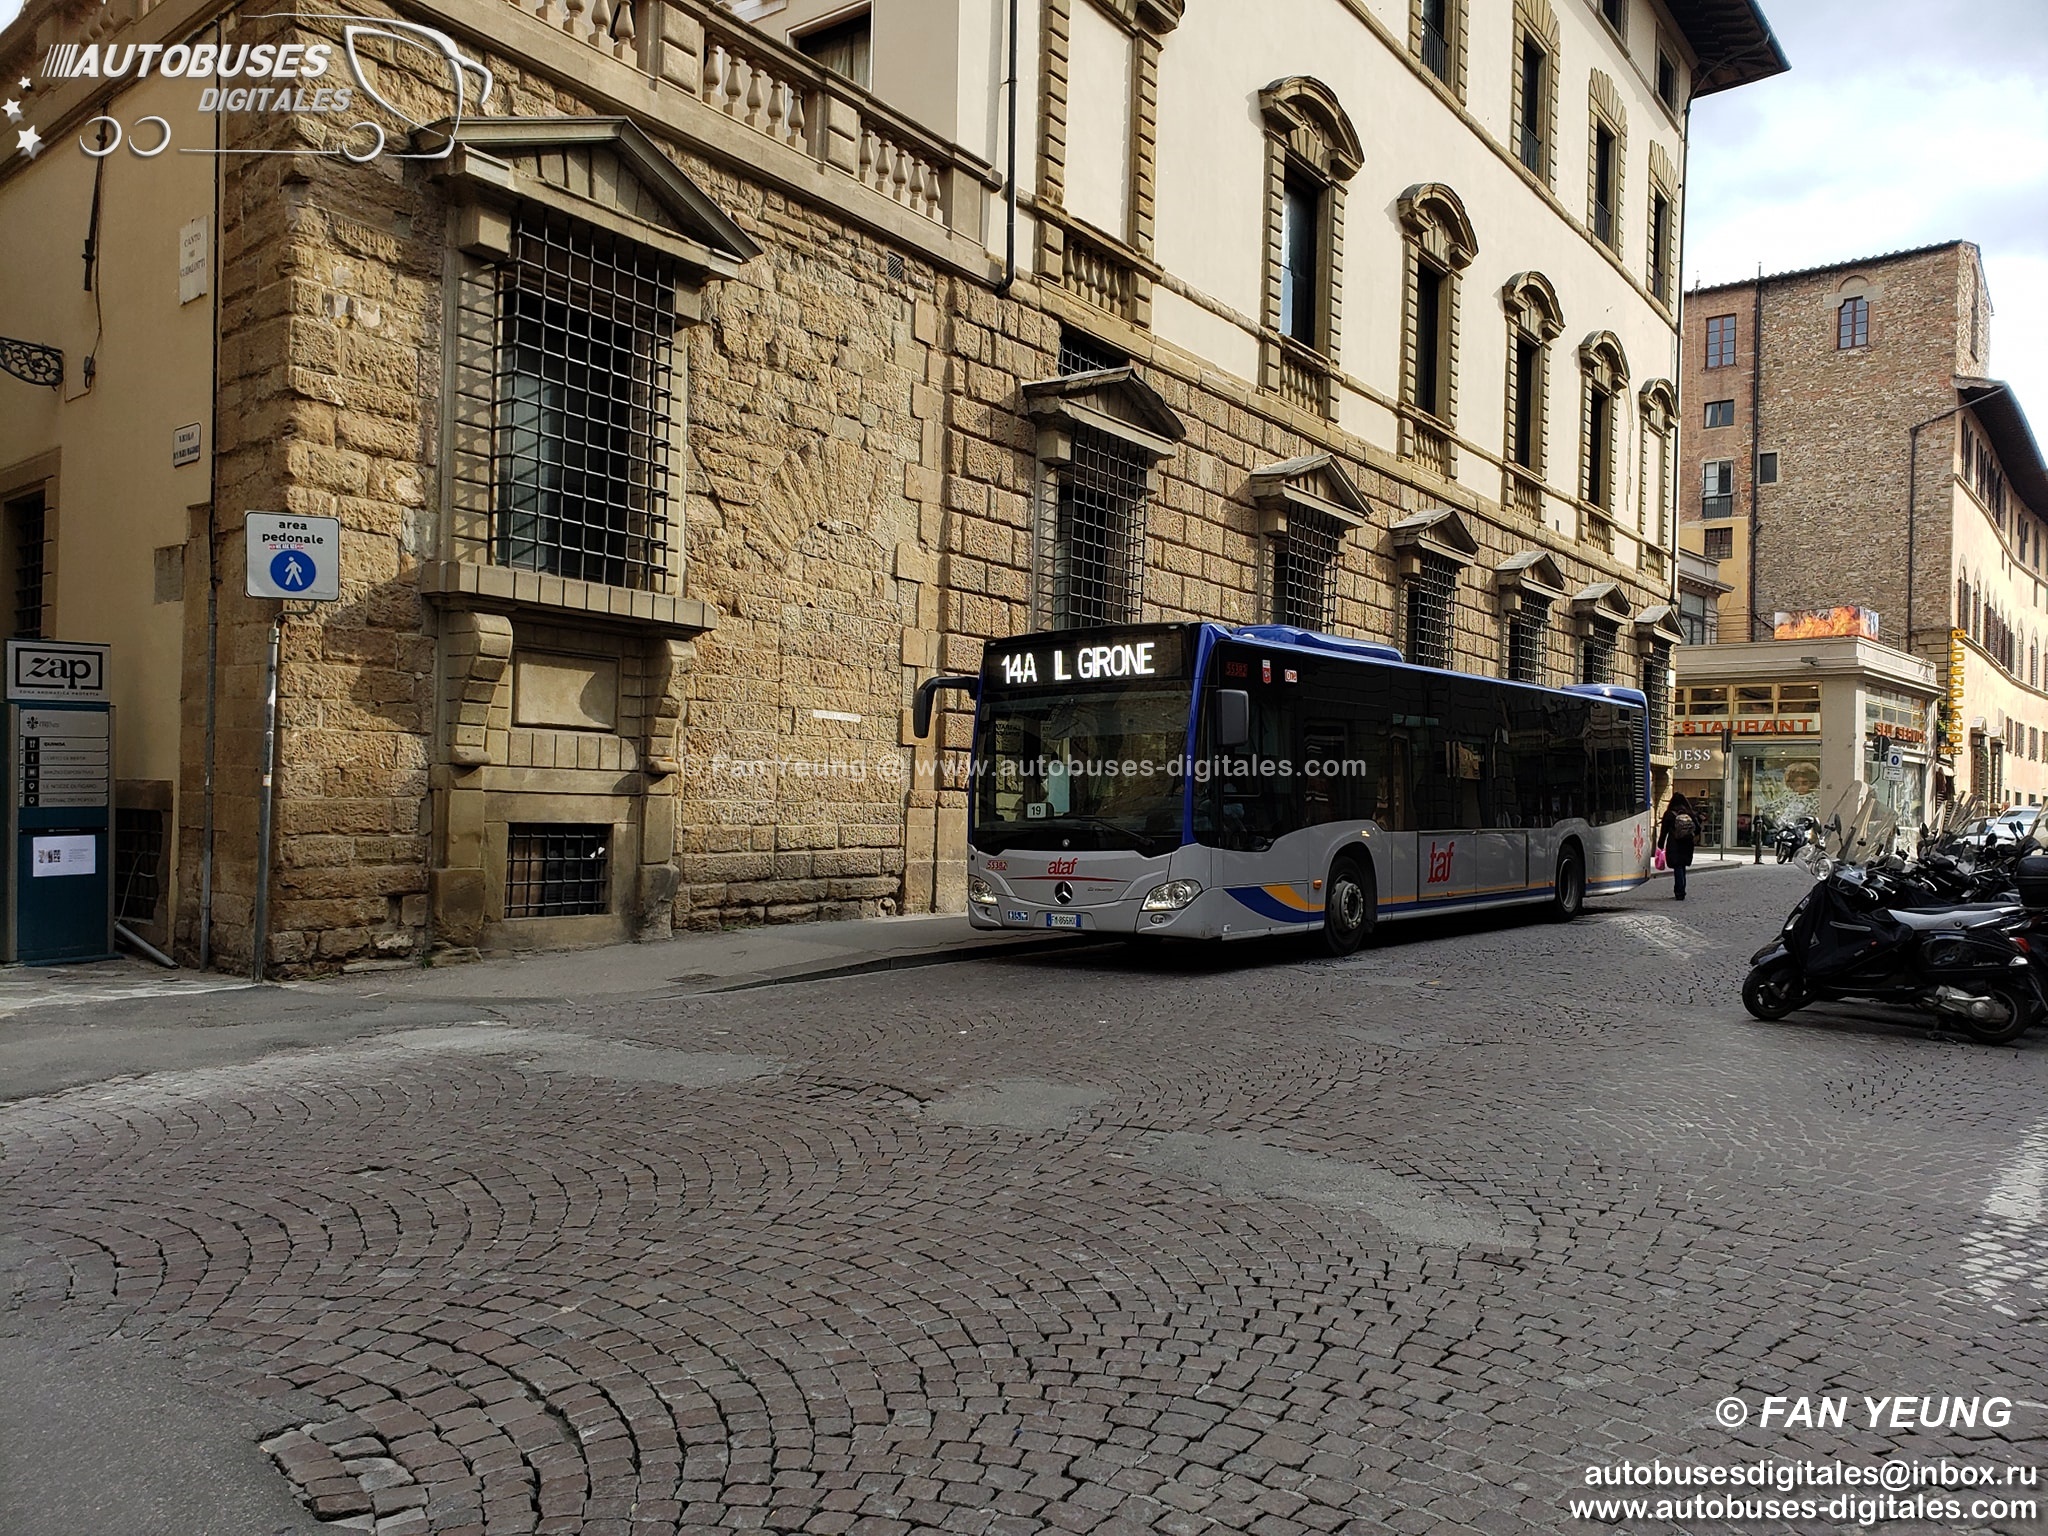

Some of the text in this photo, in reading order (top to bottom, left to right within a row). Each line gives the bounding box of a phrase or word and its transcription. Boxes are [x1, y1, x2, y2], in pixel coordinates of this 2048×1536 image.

[278, 521, 308, 530] area
[262, 532, 324, 545] pedonale
[1001, 652, 1037, 684] 14A
[1078, 642, 1155, 679] GIRONE
[25, 657, 92, 690] zap
[1673, 719, 1813, 734] ESTAURANT
[1673, 749, 1711, 762] UESS
[1031, 806, 1041, 815] 19
[1047, 857, 1078, 875] ataf
